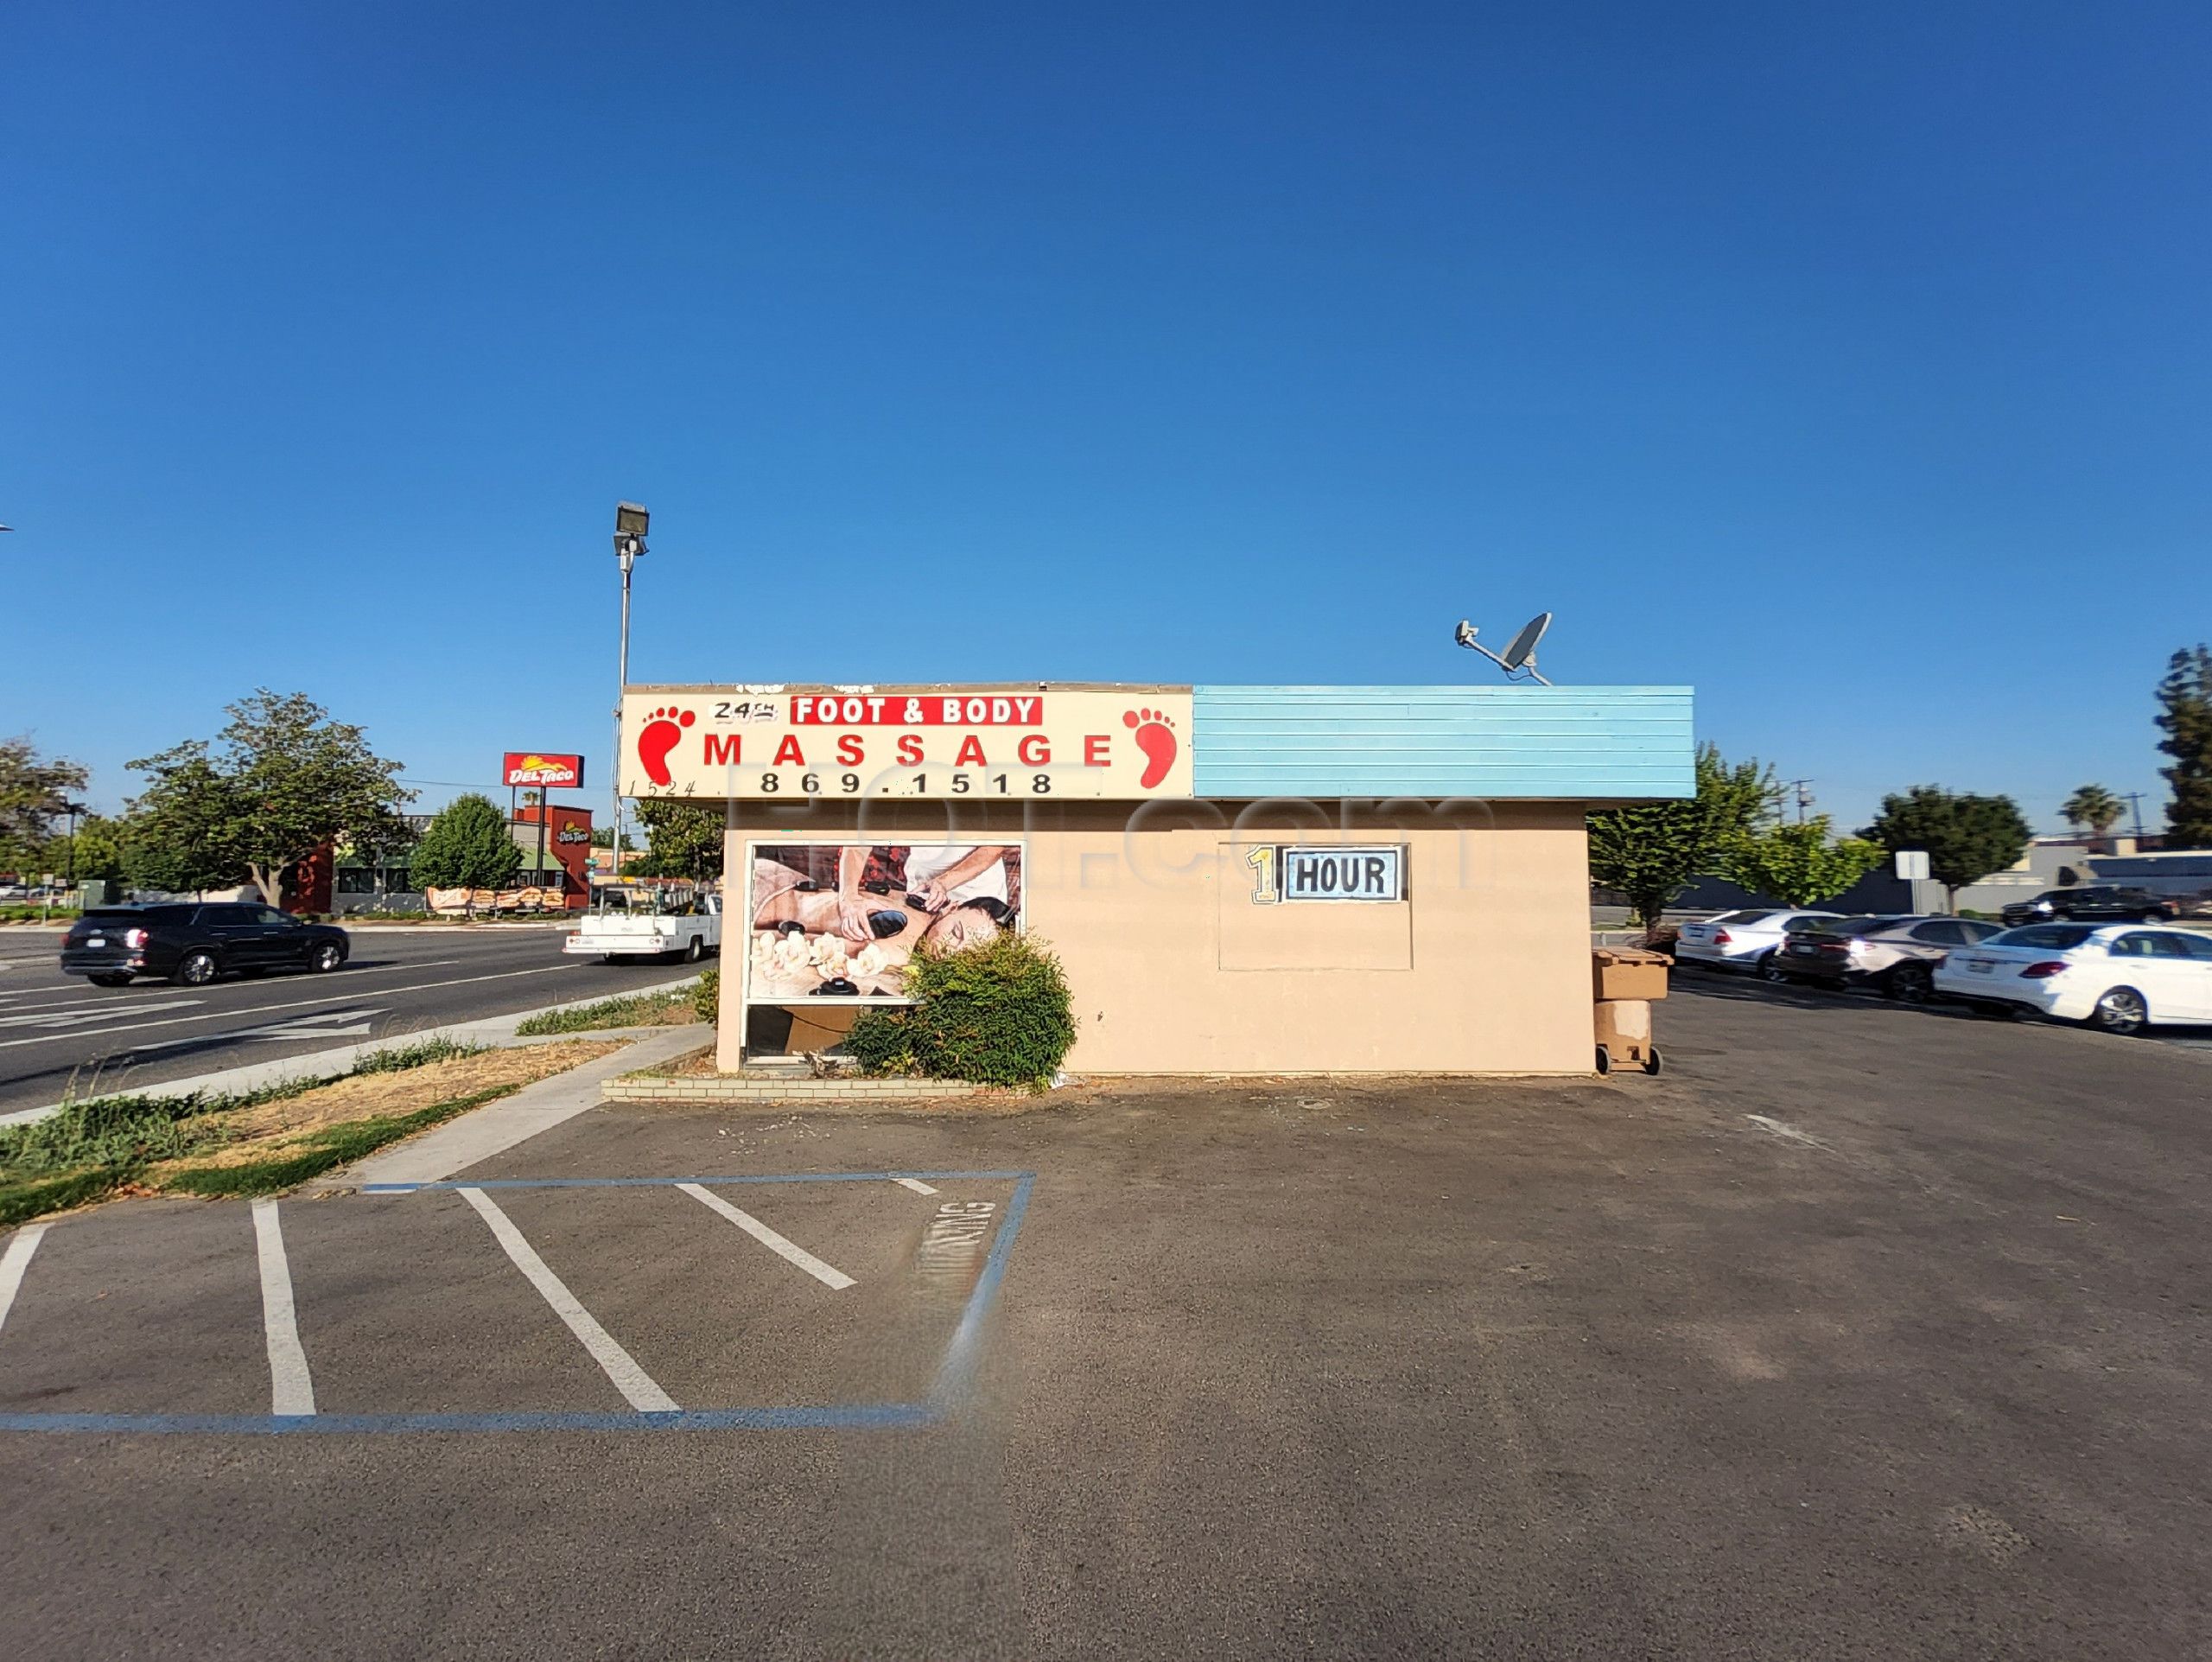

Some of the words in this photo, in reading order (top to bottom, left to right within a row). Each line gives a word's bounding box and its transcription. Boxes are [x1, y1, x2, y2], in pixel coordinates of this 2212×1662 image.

[797, 697, 885, 723] FOOT
[904, 698, 924, 723] &
[944, 698, 1034, 723] BODY
[702, 734, 1112, 767] MASSAGE
[628, 780, 696, 797] 1524
[760, 774, 1052, 793] 869.1518
[1246, 844, 1279, 903] 1
[1295, 856, 1386, 894] HOUR
